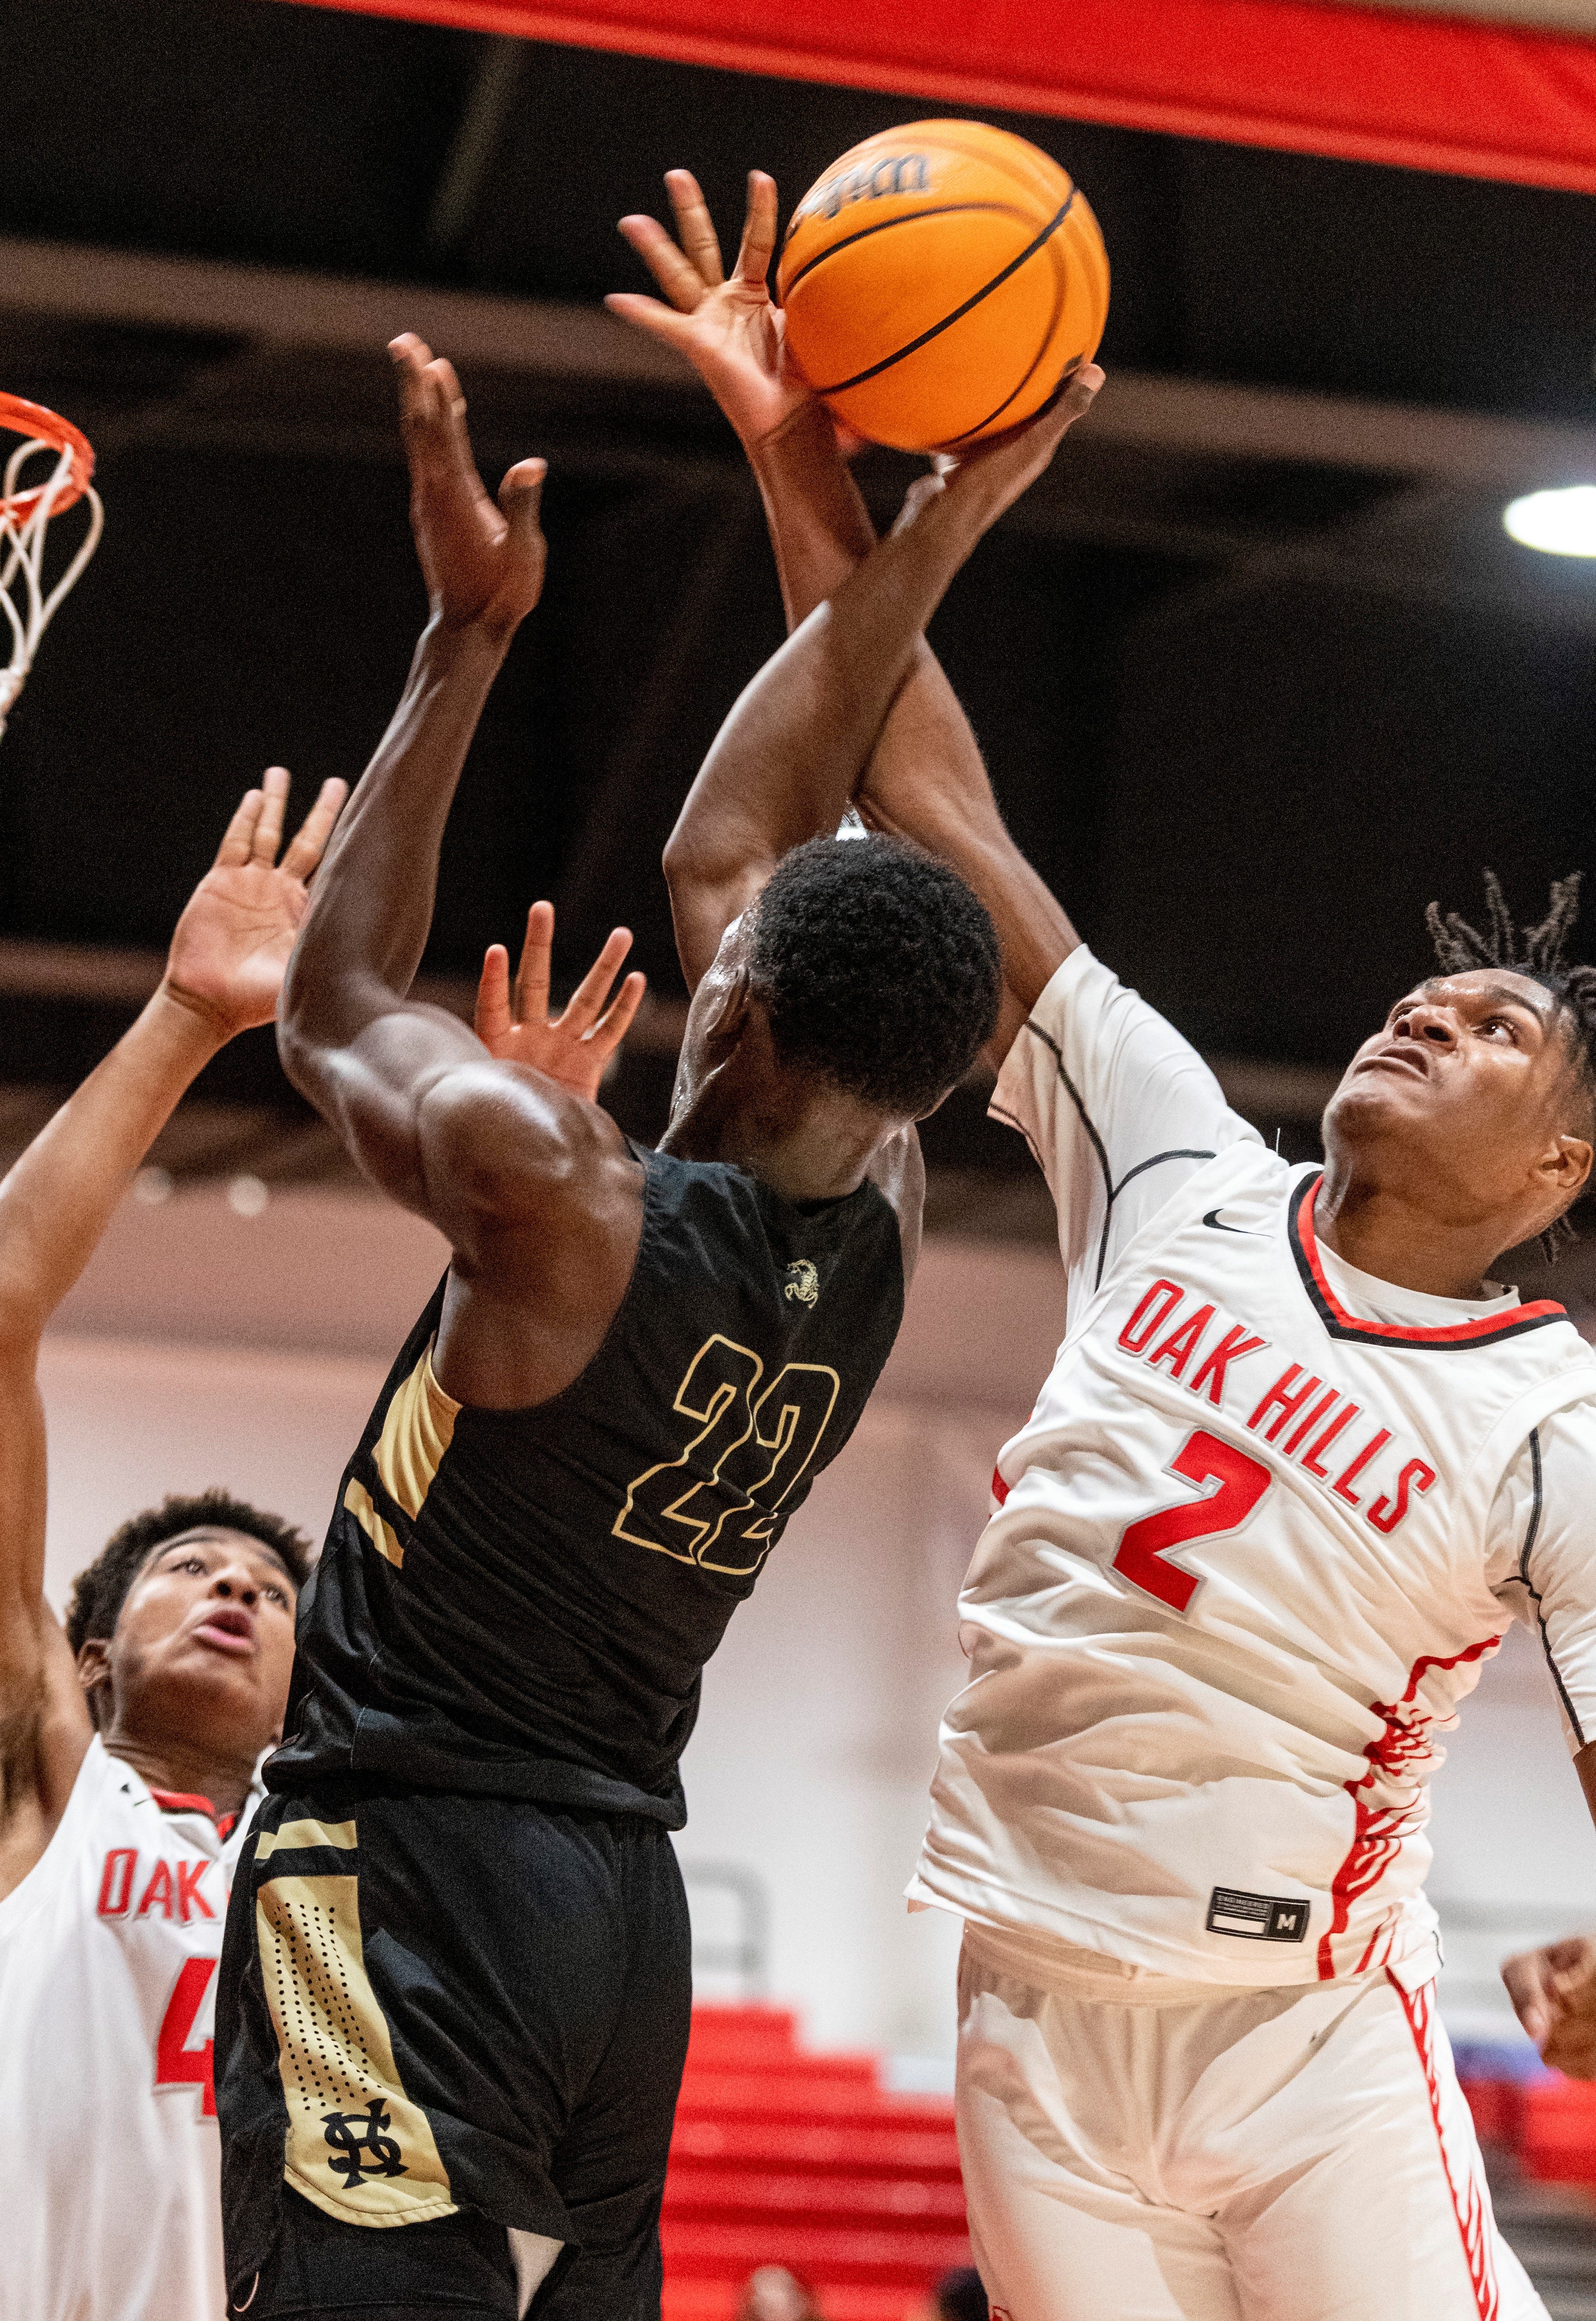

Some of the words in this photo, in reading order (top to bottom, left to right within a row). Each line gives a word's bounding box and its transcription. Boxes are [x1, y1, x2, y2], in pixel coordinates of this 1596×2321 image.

[612, 1334, 841, 1576] 22
[1117, 1279, 1268, 1408] OAK
[1246, 1362, 1437, 1535] HILLS
[1111, 1429, 1273, 1614] 2
[96, 1848, 217, 1922] OAK
[1277, 1913, 1297, 1931] M
[156, 1957, 219, 2117] 4
